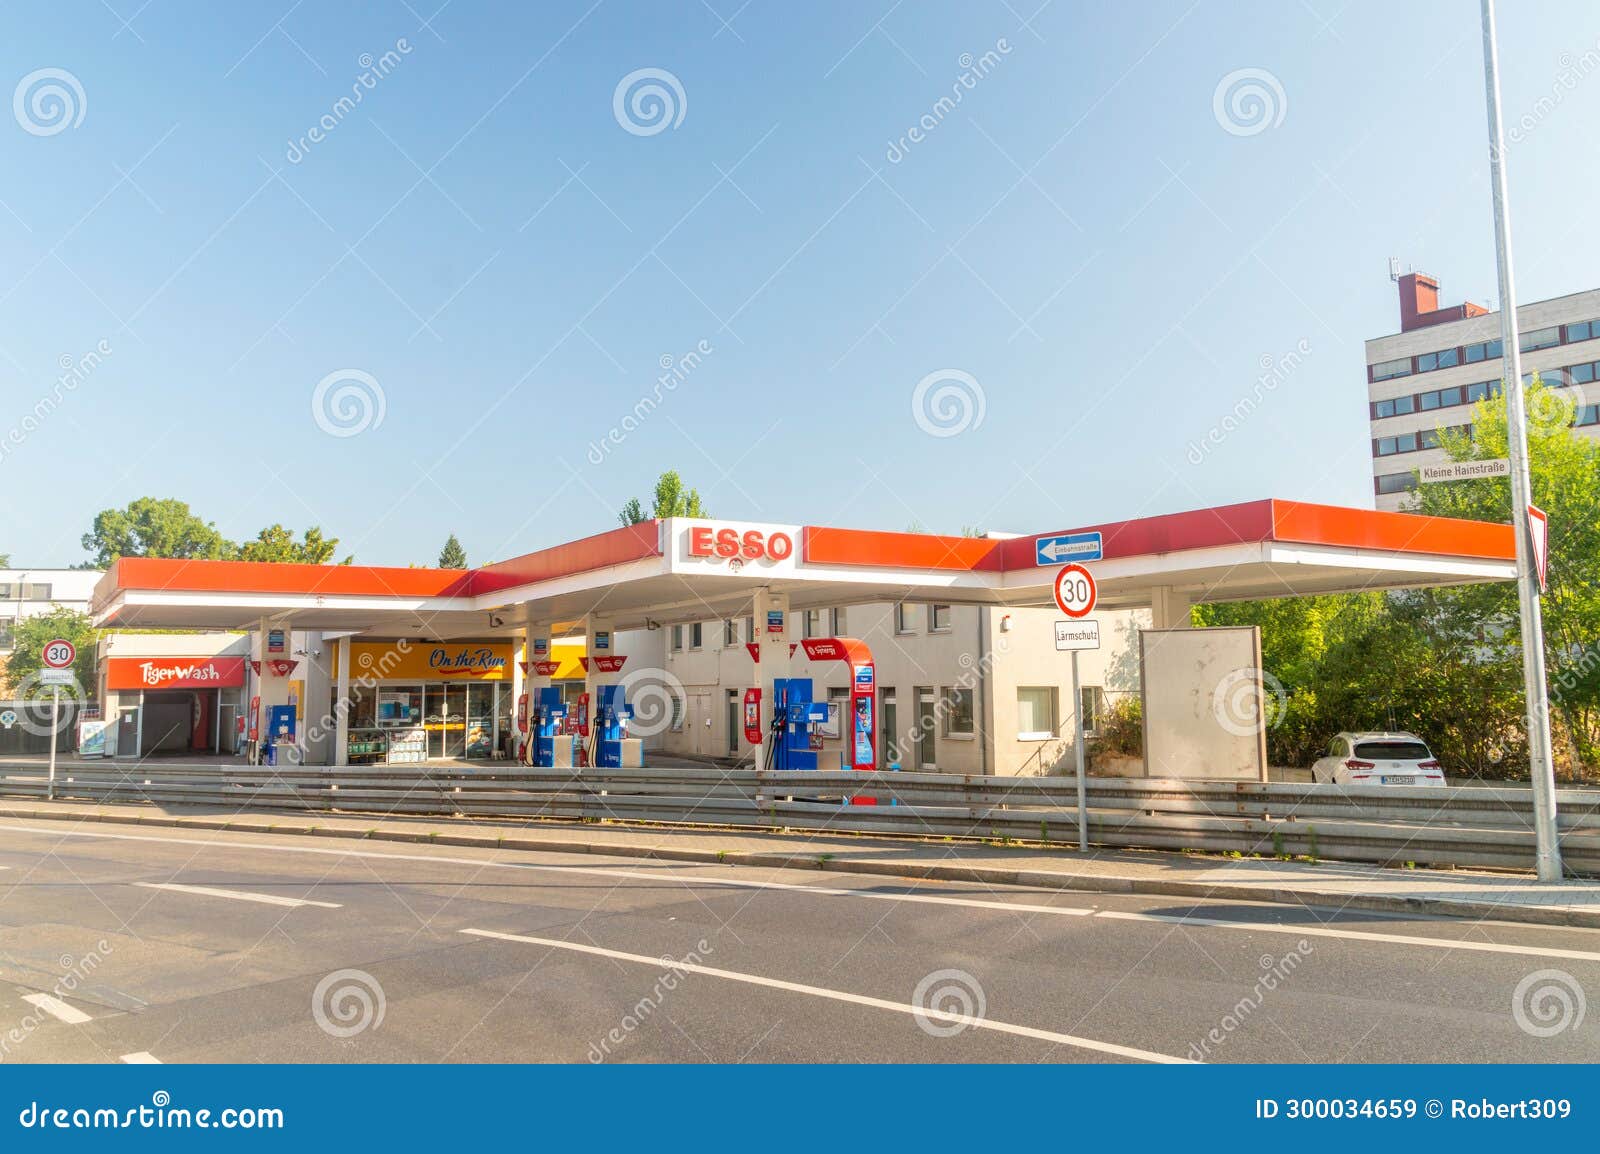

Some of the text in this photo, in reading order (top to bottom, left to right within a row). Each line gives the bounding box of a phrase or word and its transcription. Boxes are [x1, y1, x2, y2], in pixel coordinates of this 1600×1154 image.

[1424, 462, 1505, 478] Kleine Hainstraße
[688, 526, 793, 561] ESSO
[1063, 579, 1088, 603] 30
[1056, 629, 1098, 641] Lärmschutz
[49, 647, 69, 661] 30
[429, 648, 507, 670] On the Run
